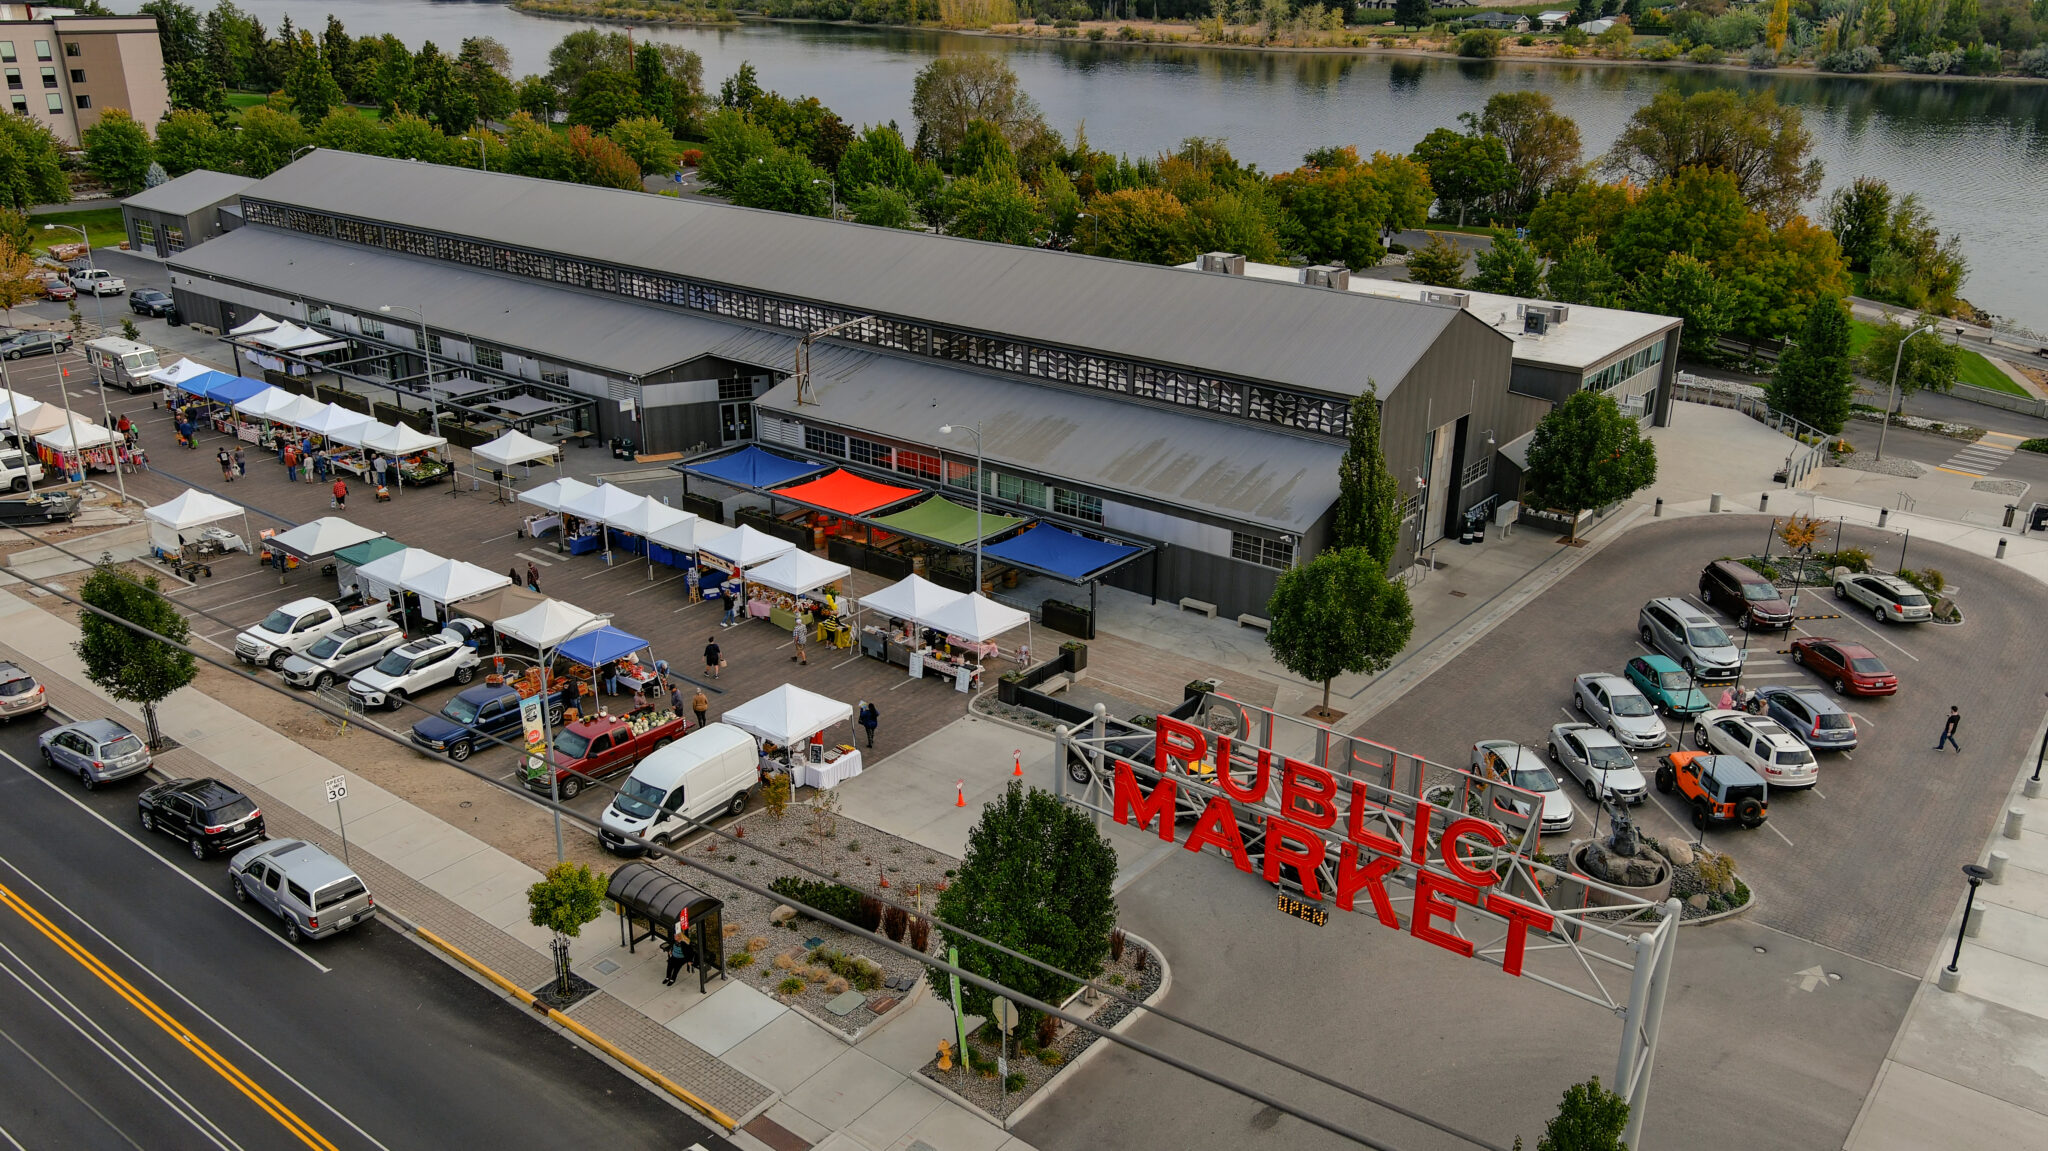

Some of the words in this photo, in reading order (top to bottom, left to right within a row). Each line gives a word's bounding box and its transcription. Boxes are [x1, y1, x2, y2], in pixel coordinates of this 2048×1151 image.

[326, 777, 343, 785] SPEED
[328, 782, 343, 790] LIMIT
[329, 787, 345, 799] 30
[1155, 714, 1507, 887] PUBLIC
[1113, 760, 1554, 977] MARKET
[1278, 895, 1324, 926] OPEN
